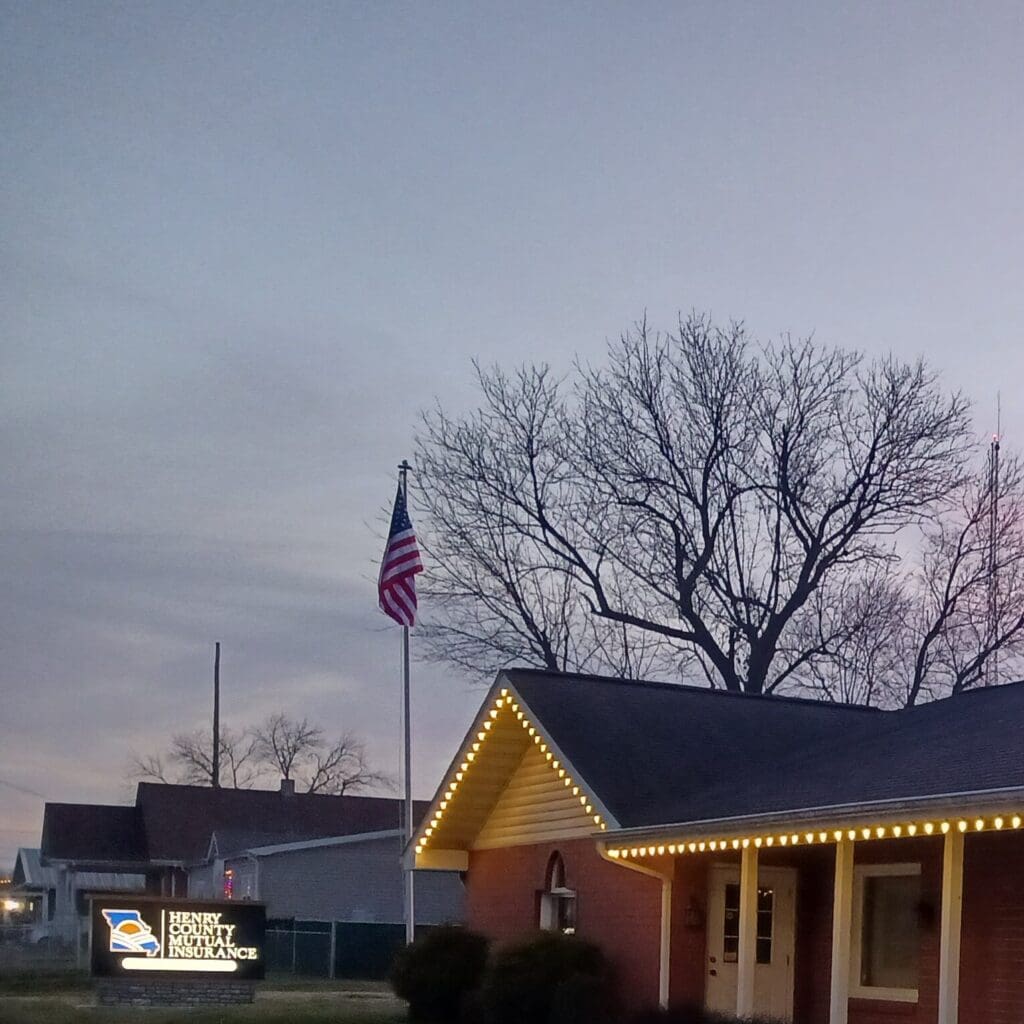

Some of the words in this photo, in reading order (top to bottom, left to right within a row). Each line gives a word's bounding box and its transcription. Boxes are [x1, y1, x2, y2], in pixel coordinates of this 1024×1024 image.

[168, 911, 222, 924] HENRY
[168, 924, 236, 936] COUNTY
[168, 936, 235, 948] MUTUAL
[168, 947, 257, 960] INSURANCE
